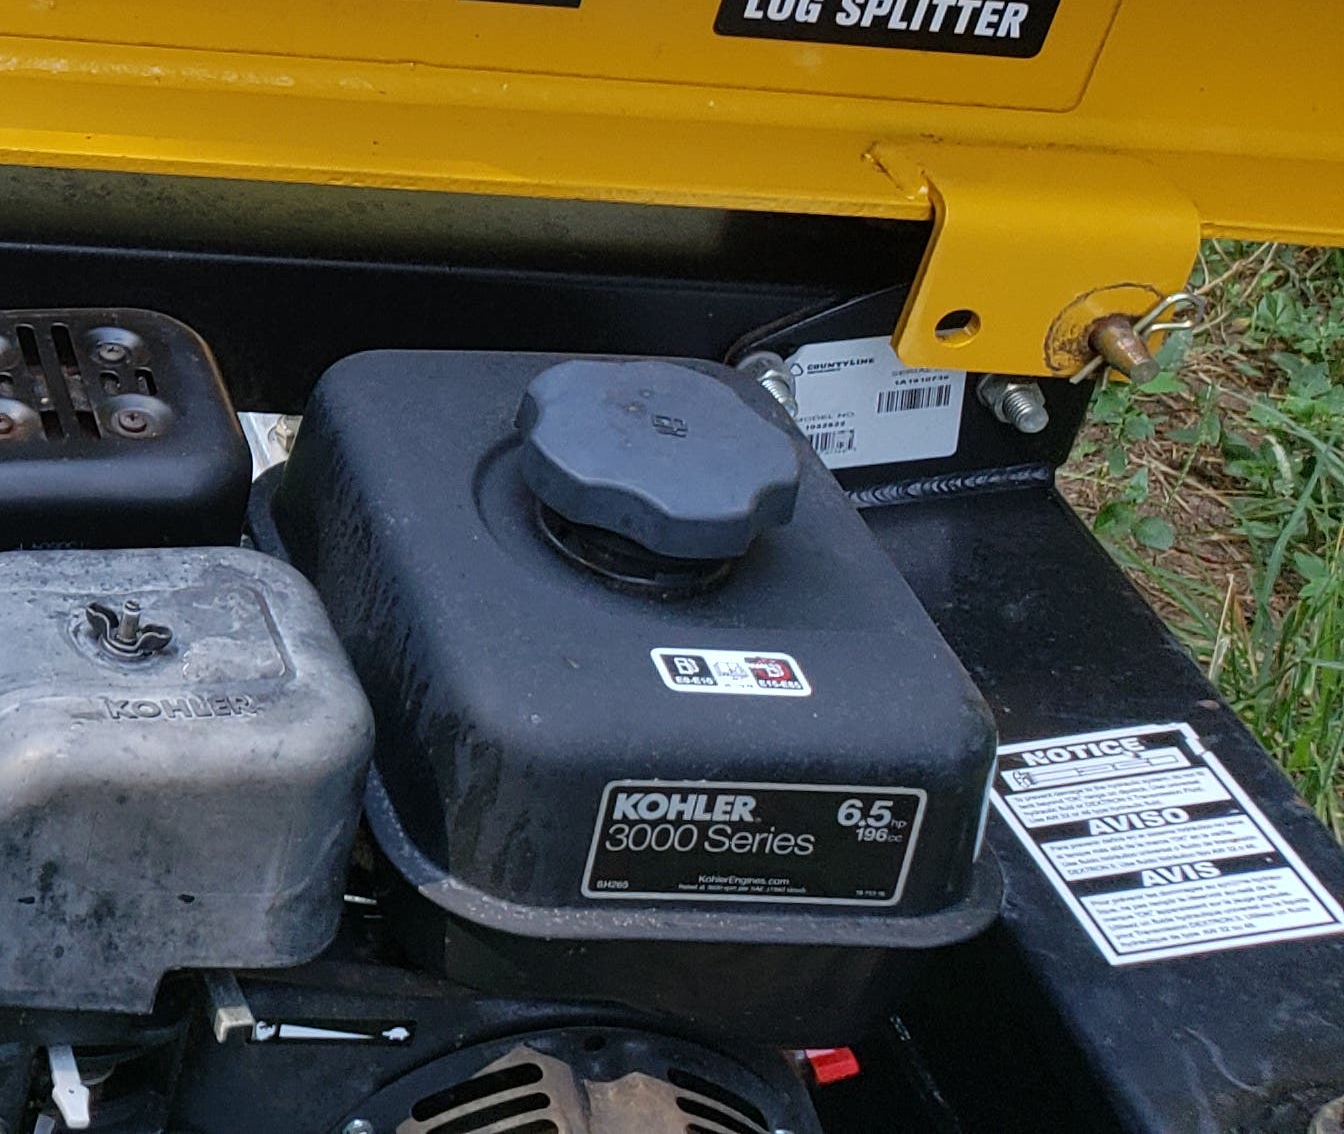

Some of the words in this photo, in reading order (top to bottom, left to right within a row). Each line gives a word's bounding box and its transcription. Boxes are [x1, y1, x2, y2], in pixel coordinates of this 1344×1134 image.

[807, 358, 875, 370] COUNTYLINE
[105, 696, 260, 720] KOHLER
[1022, 737, 1145, 766] NOTICE
[613, 793, 757, 822] KOHLER
[1089, 807, 1189, 835] AVISO
[605, 824, 698, 851] 3000
[704, 824, 815, 855] Series
[699, 875, 790, 885] KohlerEngines.com
[1141, 861, 1221, 888] AVIS
